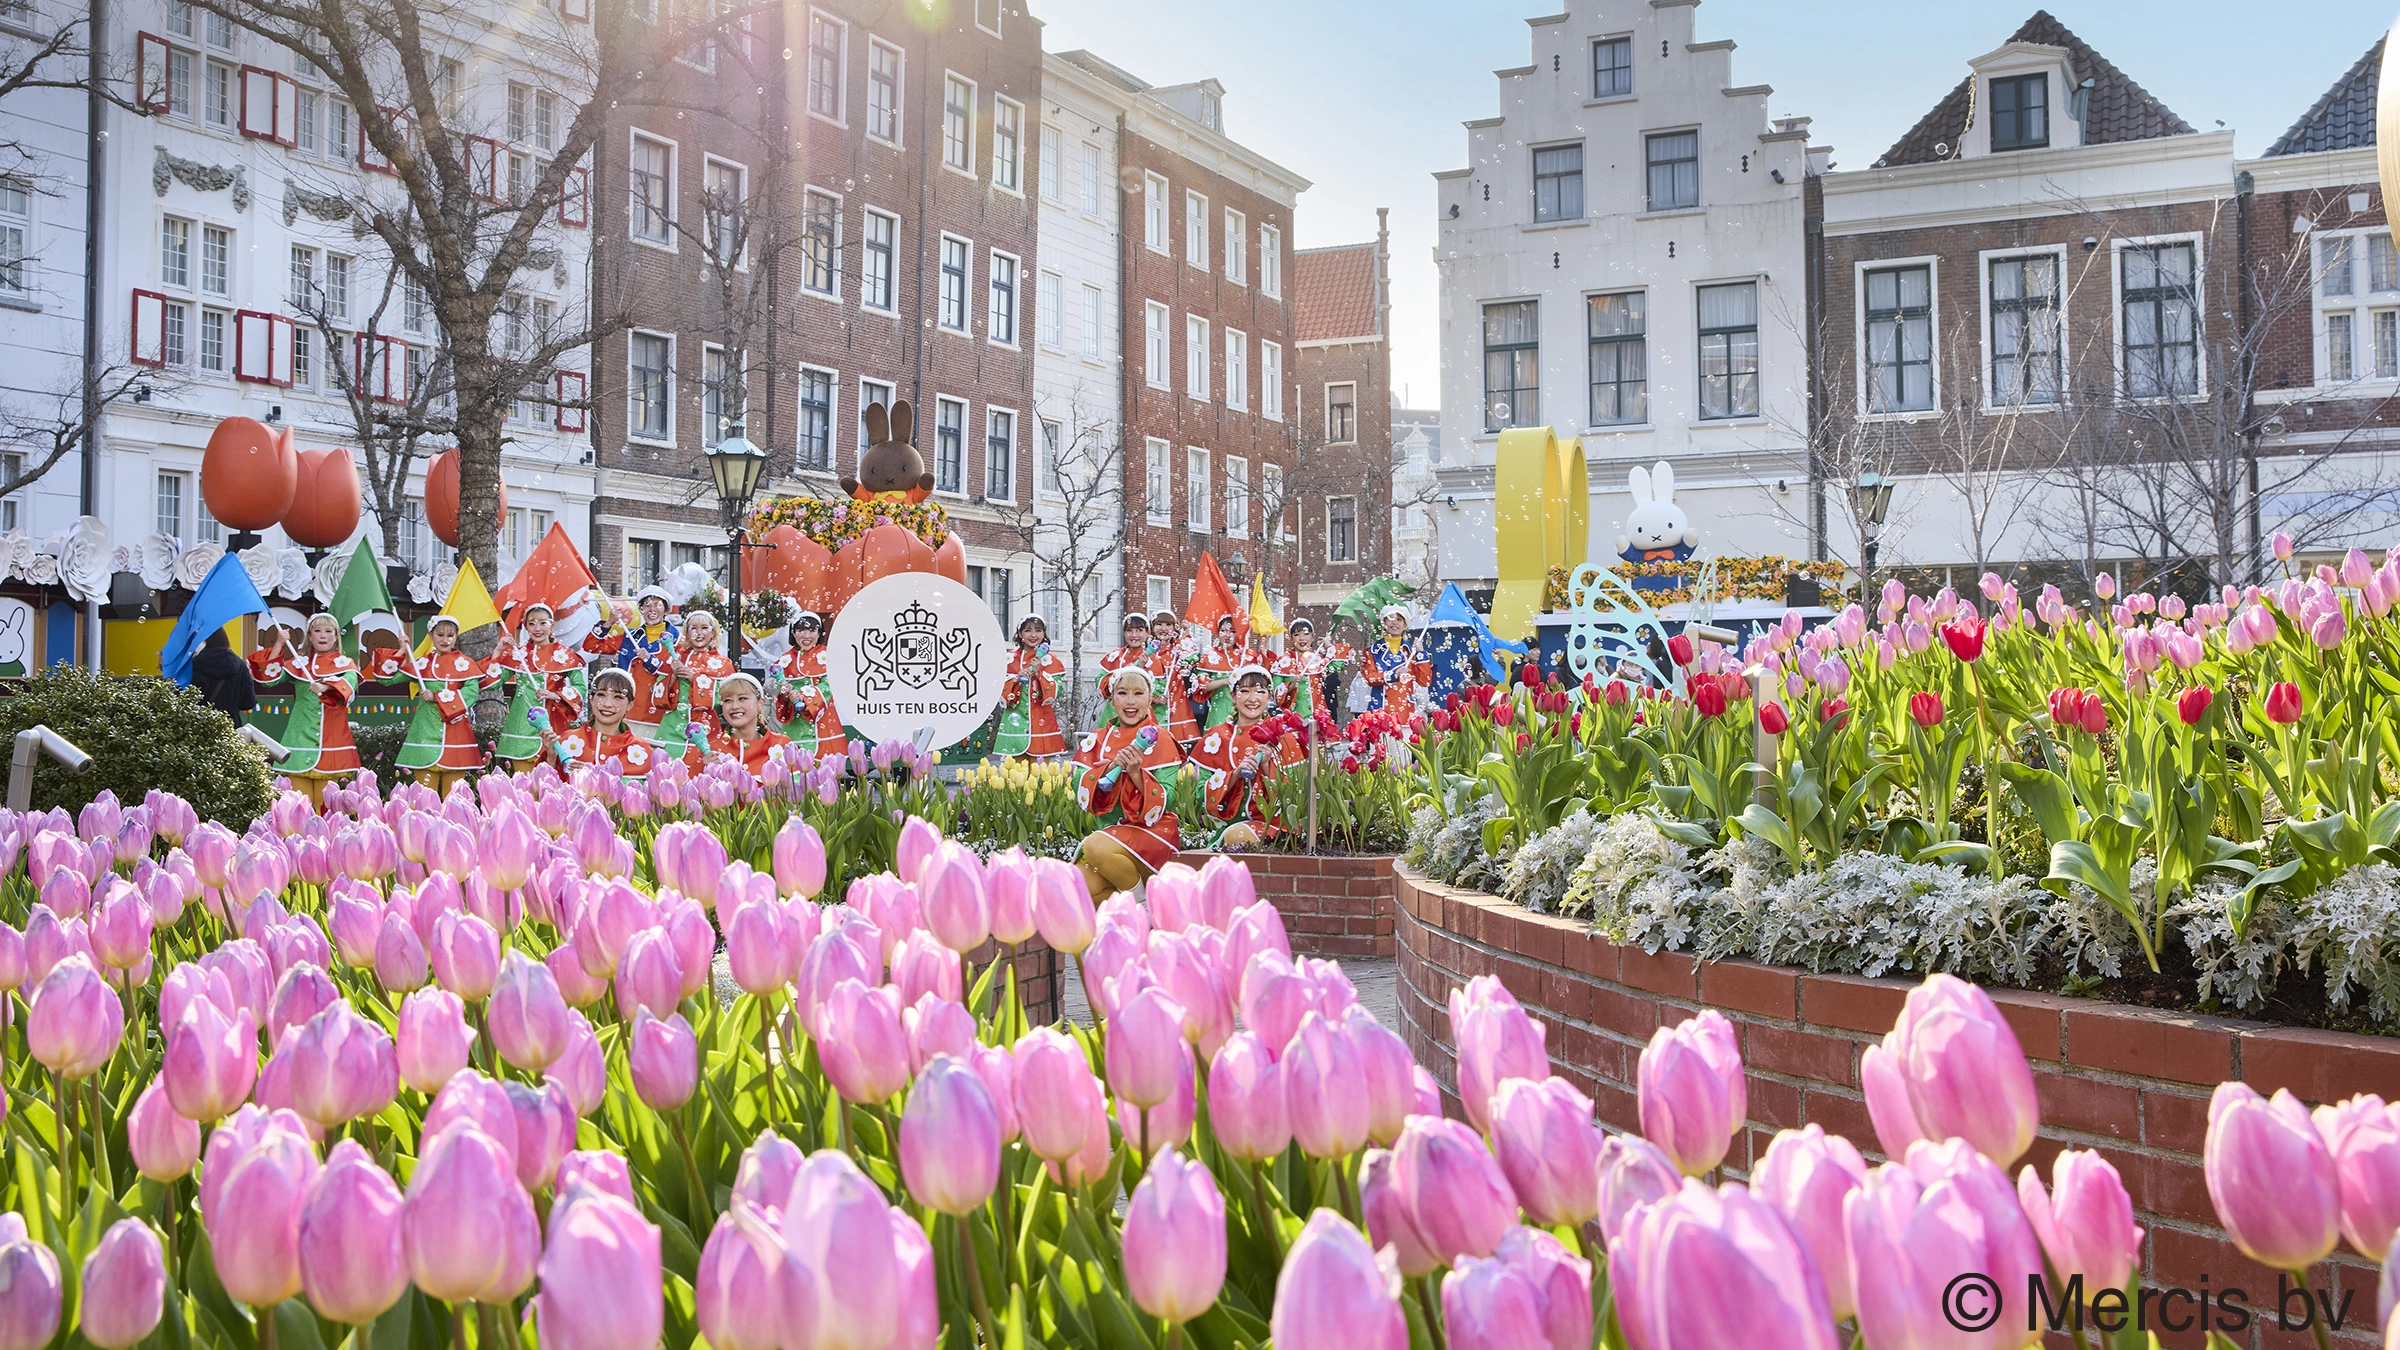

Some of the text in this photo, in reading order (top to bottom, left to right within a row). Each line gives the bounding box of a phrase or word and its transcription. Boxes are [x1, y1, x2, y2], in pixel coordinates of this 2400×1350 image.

[856, 702, 978, 715] HUIS TEN BOSCH
